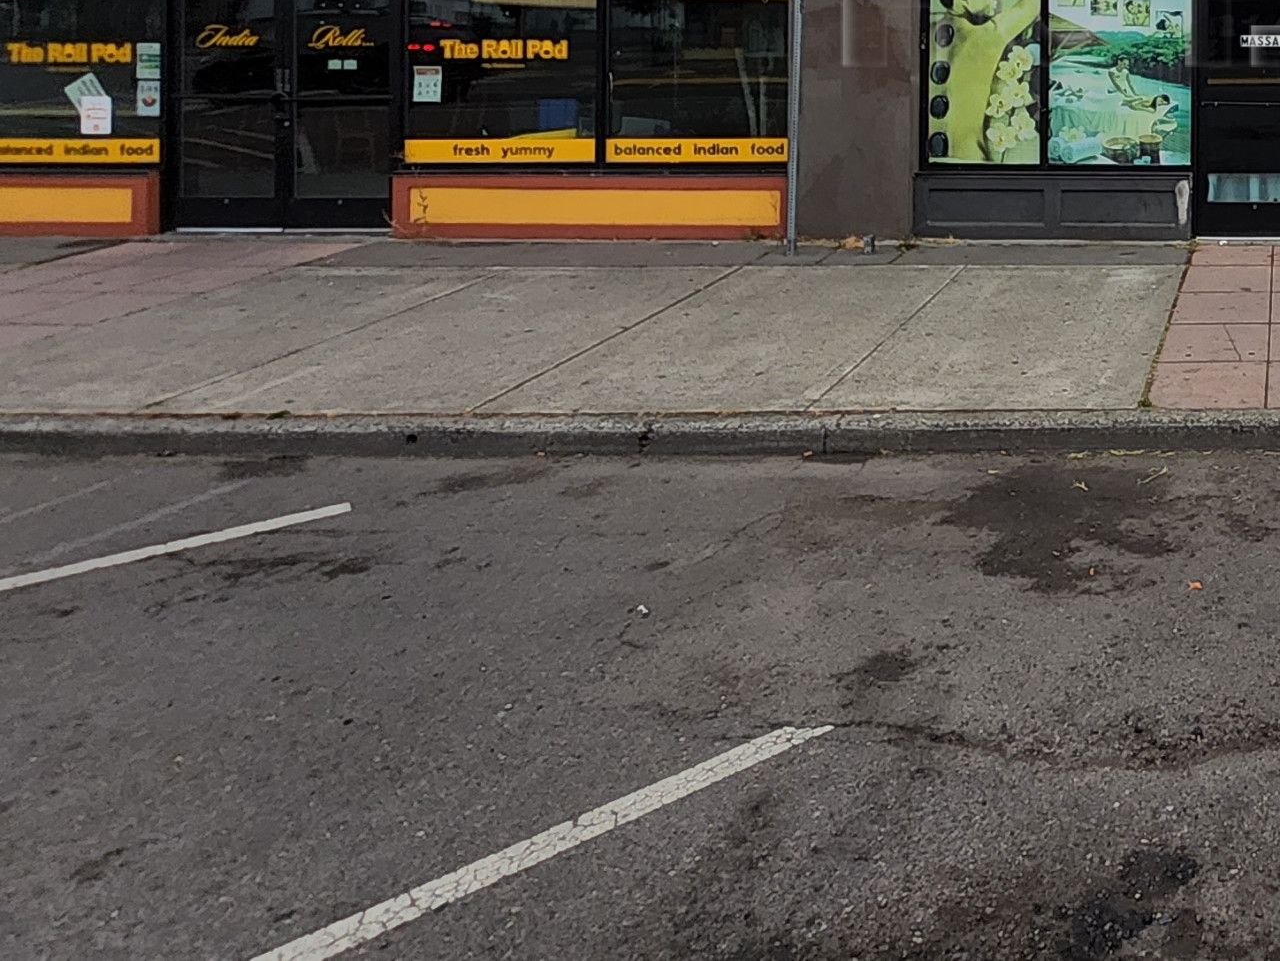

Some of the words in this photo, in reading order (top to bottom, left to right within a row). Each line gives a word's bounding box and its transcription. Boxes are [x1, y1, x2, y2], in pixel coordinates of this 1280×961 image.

[195, 24, 260, 48] India
[440, 39, 479, 59] The
[482, 39, 523, 59] Roll
[526, 39, 568, 59] Pod
[120, 143, 154, 156] food
[453, 143, 490, 156] fresh
[501, 146, 554, 160] yummy
[614, 144, 682, 155] balanced
[751, 143, 784, 155] food
